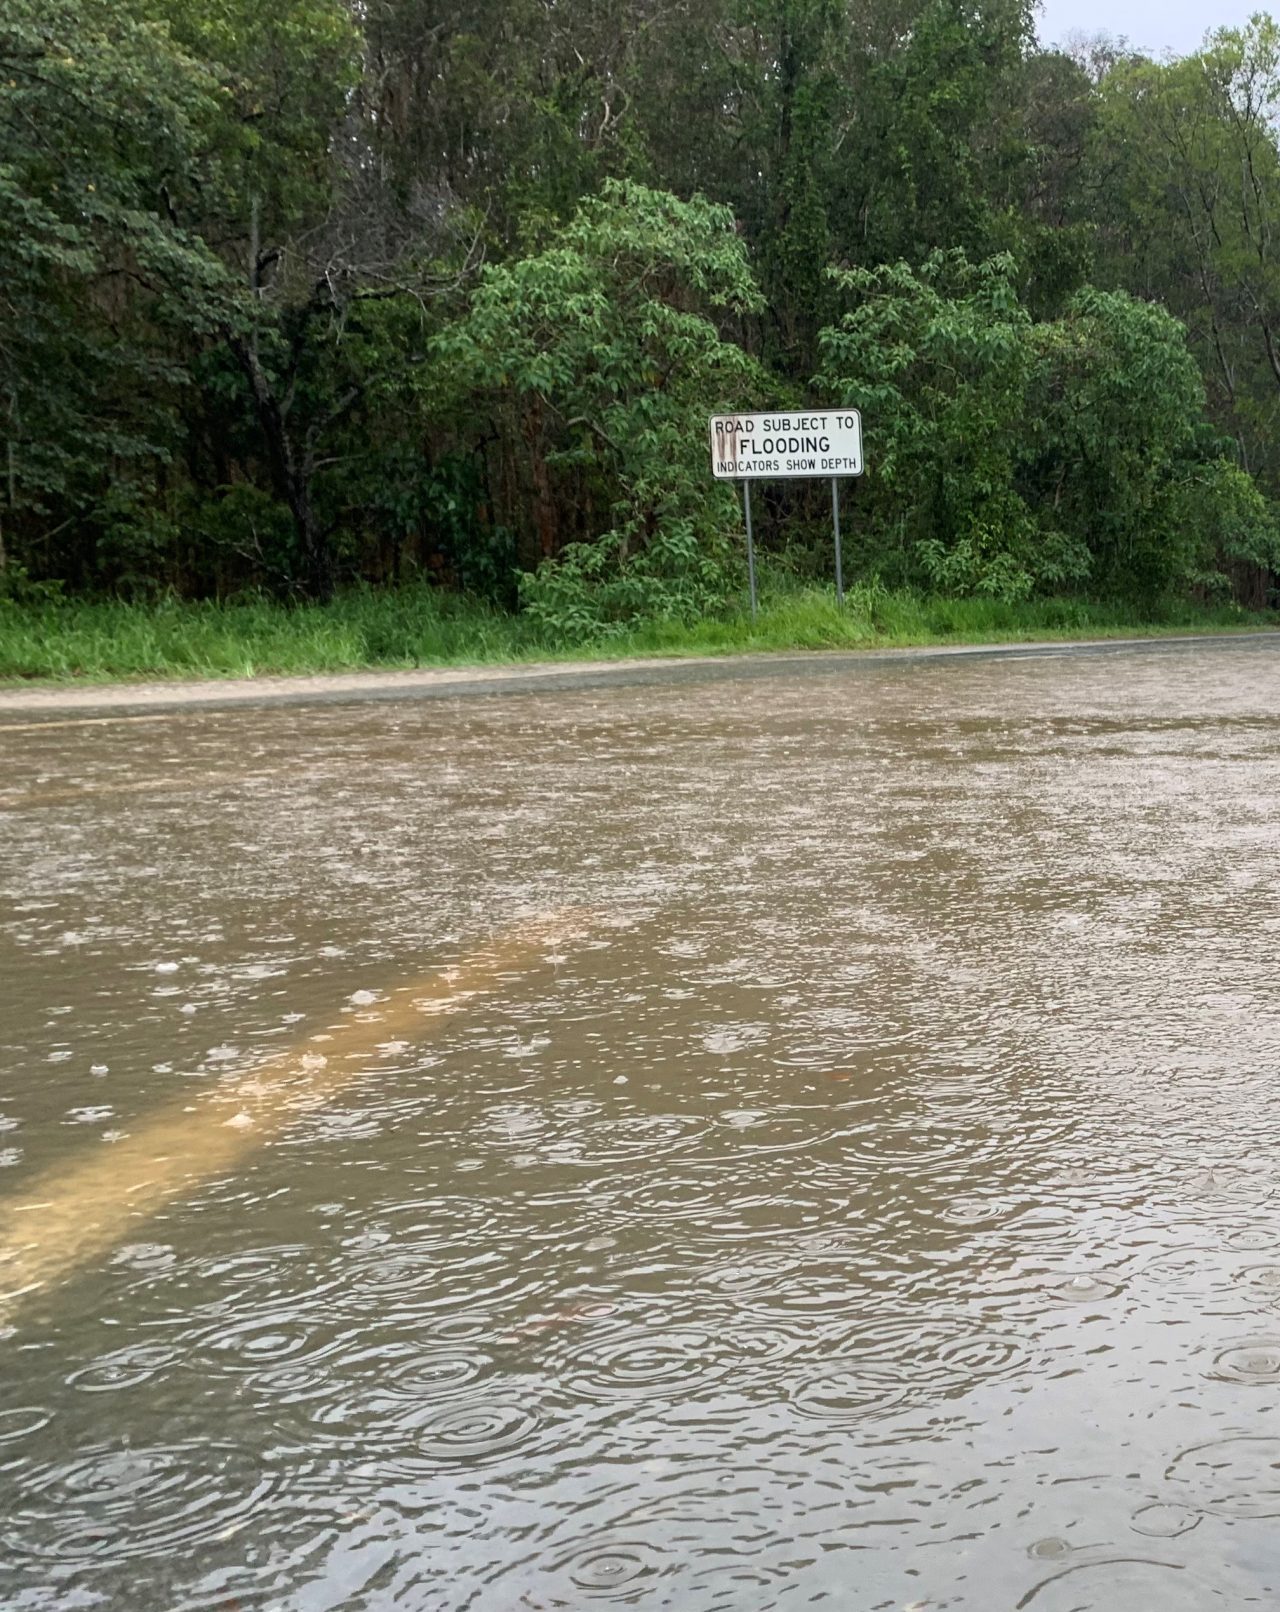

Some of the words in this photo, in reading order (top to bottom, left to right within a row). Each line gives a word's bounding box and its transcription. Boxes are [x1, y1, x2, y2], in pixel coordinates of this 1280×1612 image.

[715, 420, 754, 434] ROAD
[763, 417, 827, 432] SUBJECT
[836, 416, 854, 429] TO
[740, 436, 830, 455] FLOODING
[717, 459, 779, 473] INDICATORS
[786, 458, 815, 470] SHOW
[821, 458, 856, 470] DEPTH
